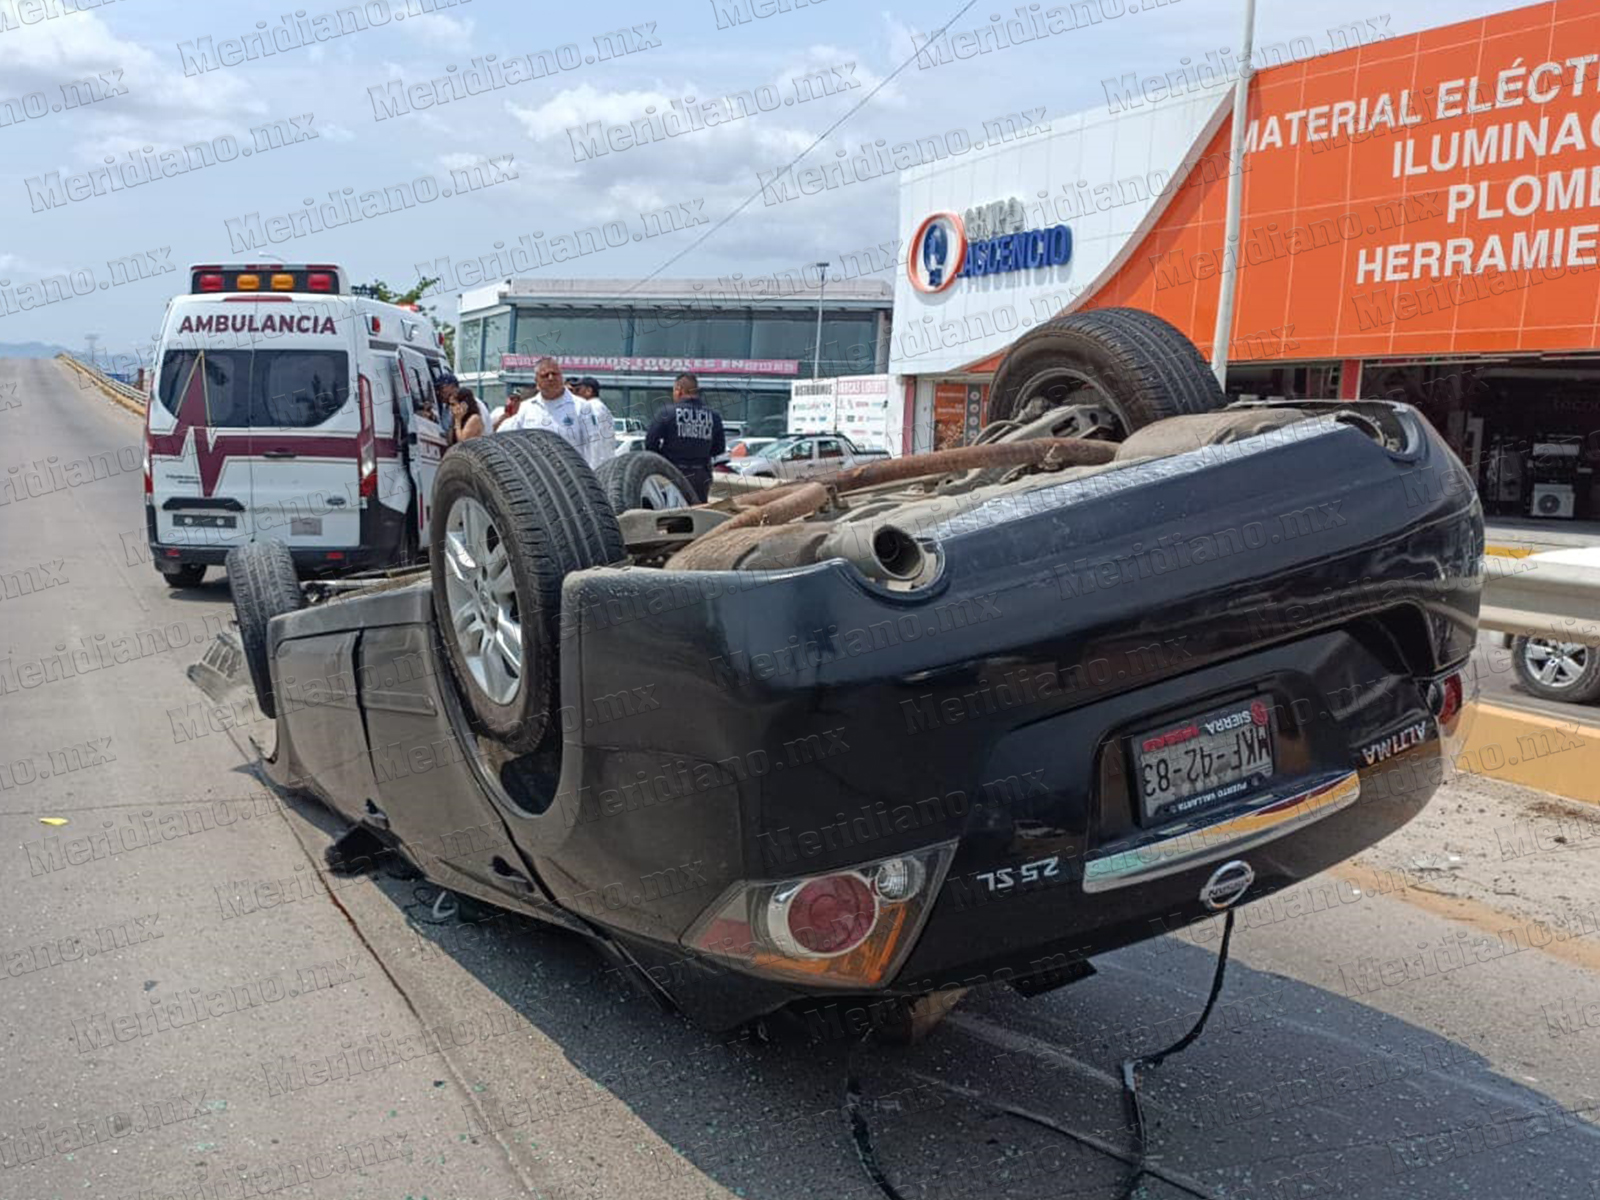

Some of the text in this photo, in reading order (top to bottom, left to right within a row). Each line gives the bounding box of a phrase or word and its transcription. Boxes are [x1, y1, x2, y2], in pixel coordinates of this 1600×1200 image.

[1436, 53, 1600, 121] ELÉCT
[961, 224, 1073, 278] ASCENCIO
[1356, 224, 1600, 285] HERRAMIE
[179, 315, 337, 335] AMBULANCIA
[1205, 710, 1251, 736] SIERRA
[1361, 720, 1426, 765] ALTIMA
[1142, 725, 1271, 797] MKF-42-83
[1177, 781, 1248, 812] PUERTO VALLARTA
[976, 867, 1014, 892] SL
